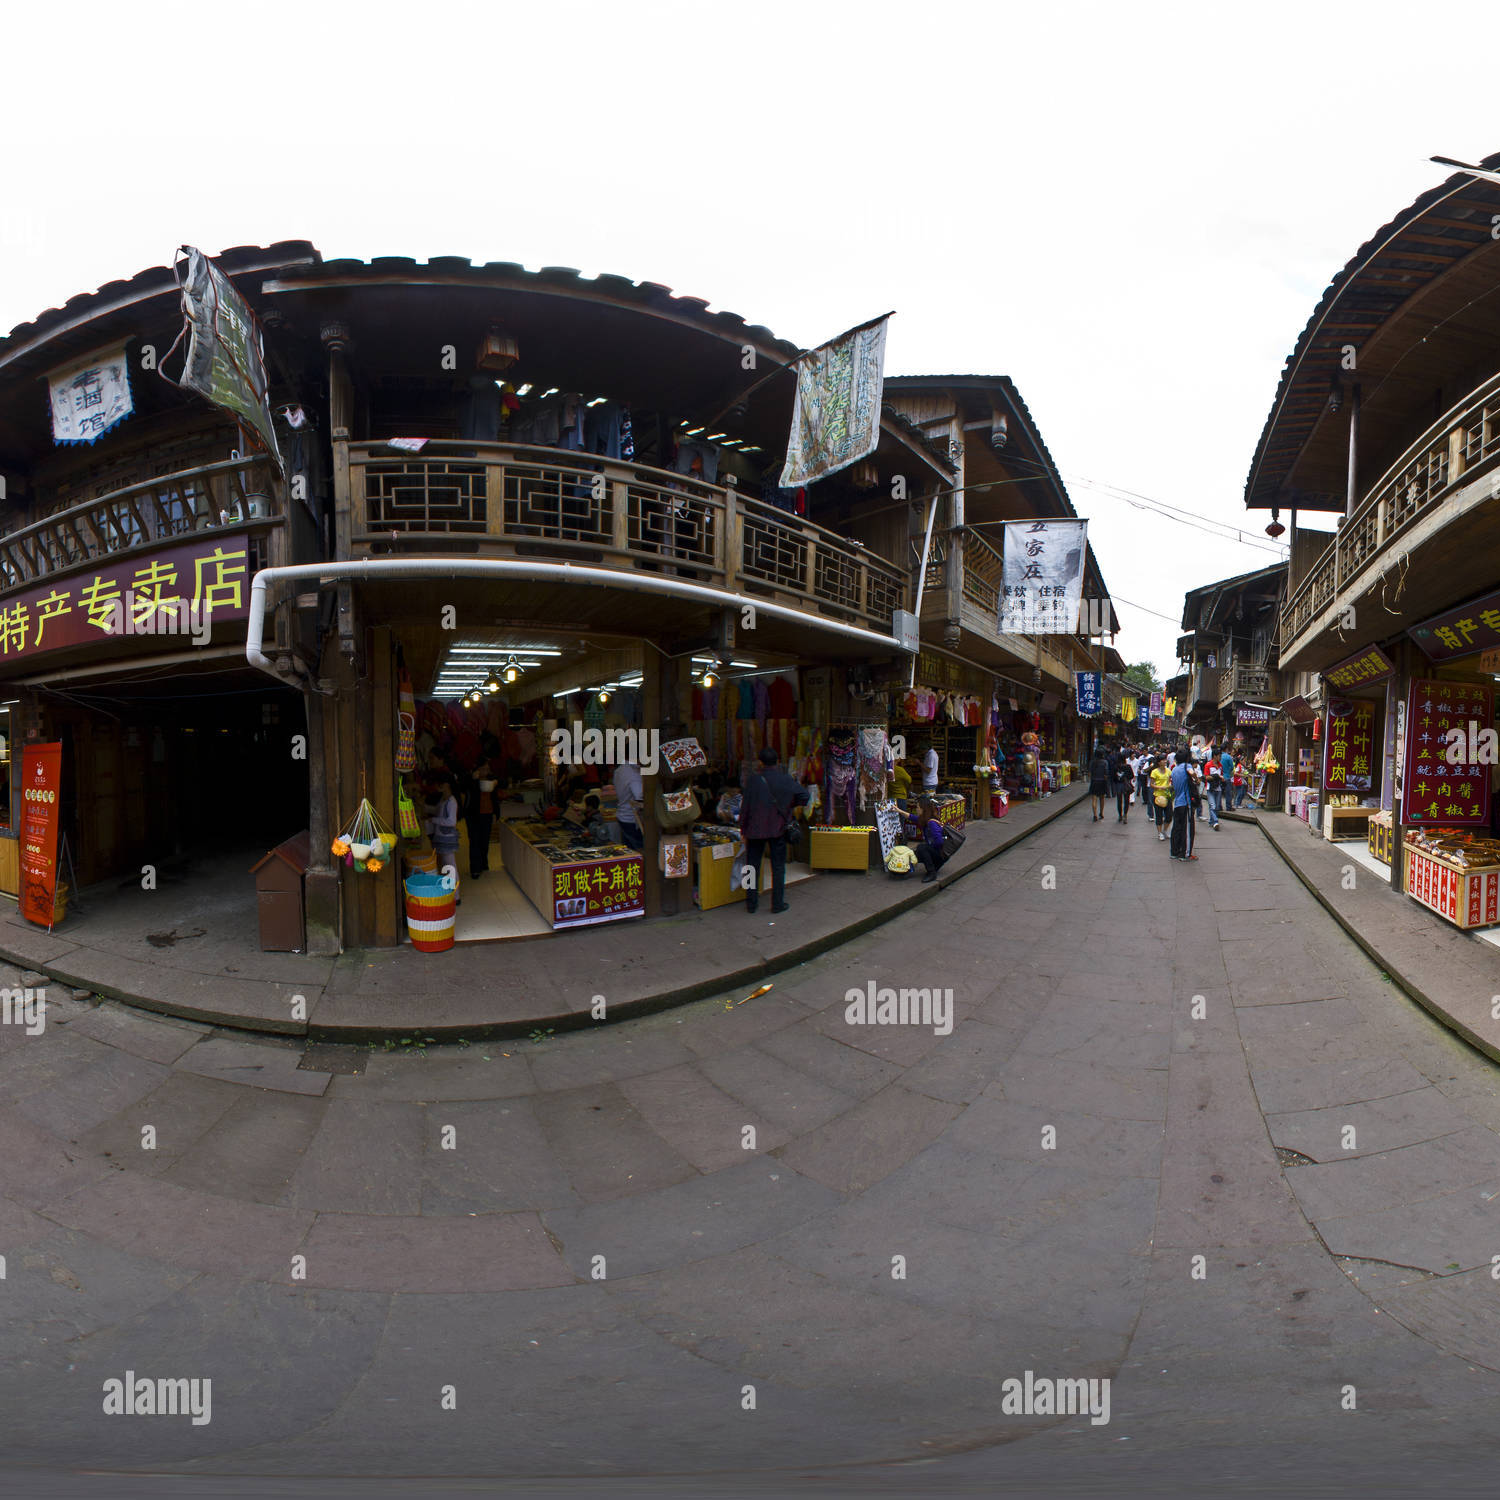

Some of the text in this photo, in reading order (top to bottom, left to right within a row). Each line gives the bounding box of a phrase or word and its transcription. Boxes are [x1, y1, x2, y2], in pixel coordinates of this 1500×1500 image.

[0, 547, 247, 655] 特产专卖店
[1039, 585, 1066, 598] 住宿
[1329, 717, 1349, 783] 竹筒肉
[1352, 710, 1371, 776] 竹叶糕
[1424, 801, 1482, 818] 青椒王
[555, 863, 643, 897] 现做牛角梳
